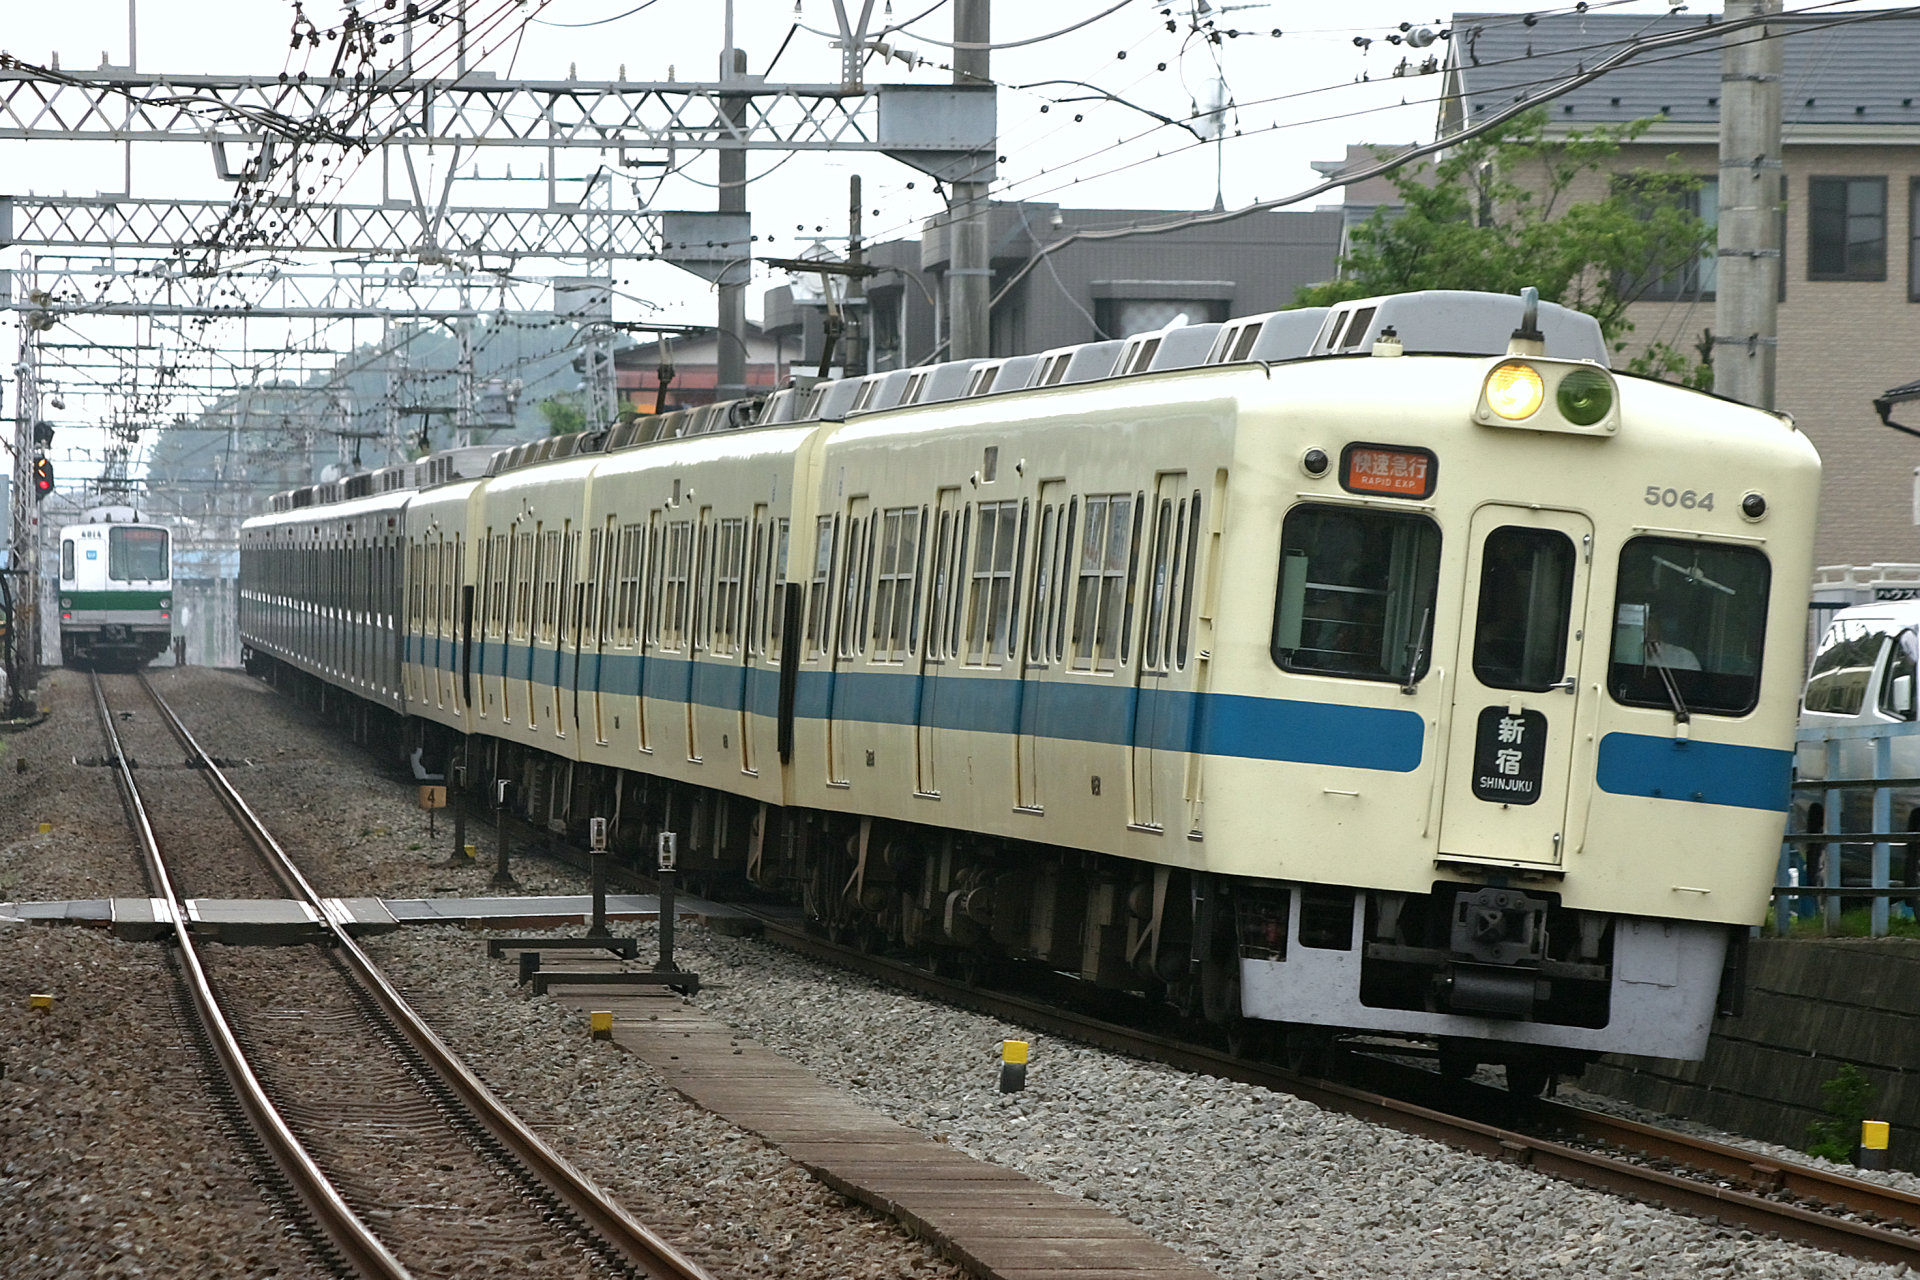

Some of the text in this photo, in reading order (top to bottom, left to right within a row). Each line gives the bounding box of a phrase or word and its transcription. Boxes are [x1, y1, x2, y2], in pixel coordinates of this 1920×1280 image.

[1354, 452, 1427, 478] 快速急行
[1361, 476, 1392, 487] RAPID
[1644, 486, 1715, 512] 5064
[1495, 716, 1525, 775] 新宿
[1480, 776, 1533, 792] SHINJUKU
[427, 788, 436, 804] 4
